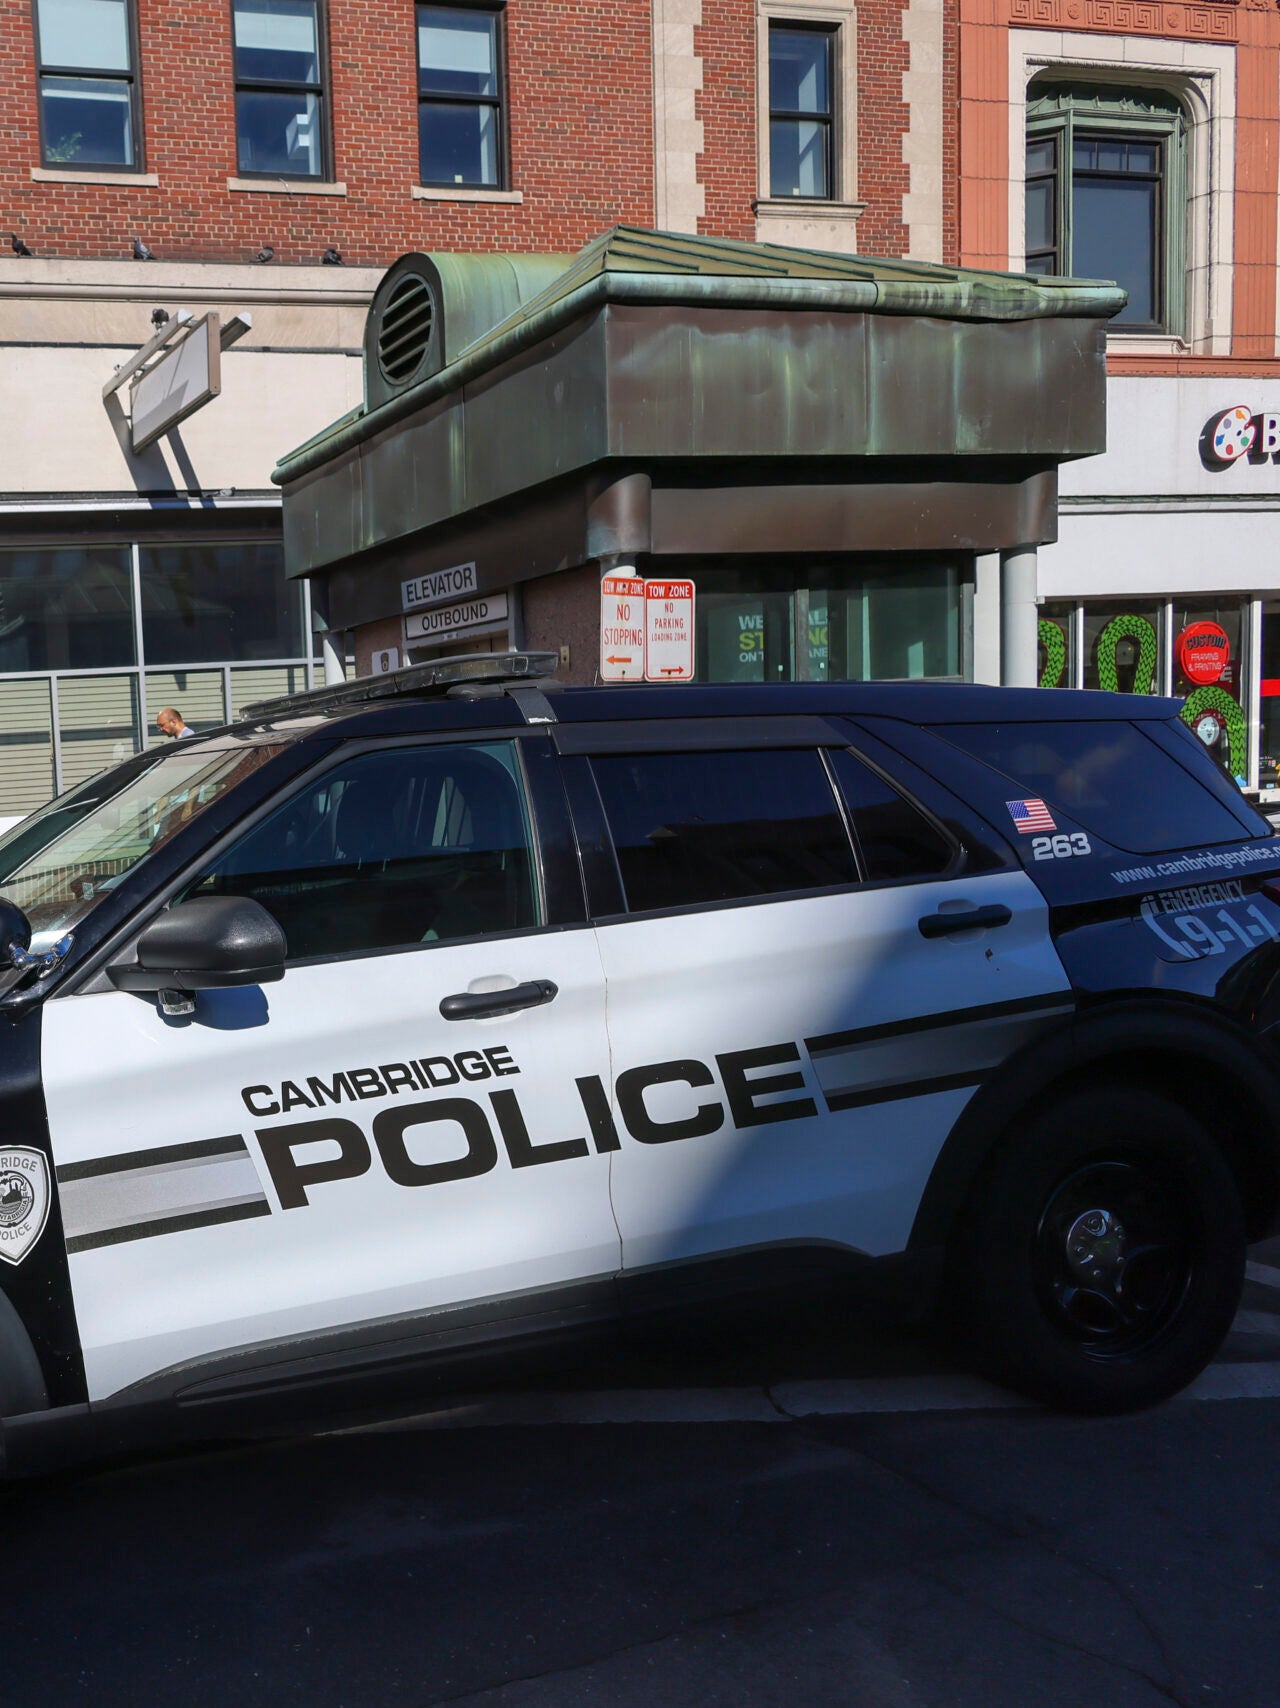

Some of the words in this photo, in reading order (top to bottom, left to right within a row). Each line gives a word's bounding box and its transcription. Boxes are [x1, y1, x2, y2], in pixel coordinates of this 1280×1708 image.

[406, 567, 473, 603] ELEVATOR
[604, 580, 614, 593] TOW
[631, 582, 643, 595] ZONE
[649, 586, 665, 597] TOW
[669, 586, 690, 597] ZONE
[617, 604, 631, 621] NO
[665, 602, 674, 613] NO
[422, 602, 488, 631] OUTBOUND
[655, 618, 684, 630] PARKING
[604, 628, 642, 647] STOPPING
[651, 633, 673, 642] LOADING
[674, 632, 687, 641] ZONE
[1185, 634, 1226, 650] CUSTOM
[739, 651, 757, 663] ON
[1195, 662, 1222, 672] PRINTING
[1031, 832, 1092, 861] 263
[1159, 880, 1247, 914] EMERGENCY
[240, 1045, 522, 1117] CAMBRIDGE
[254, 1041, 819, 1211] POLICE
